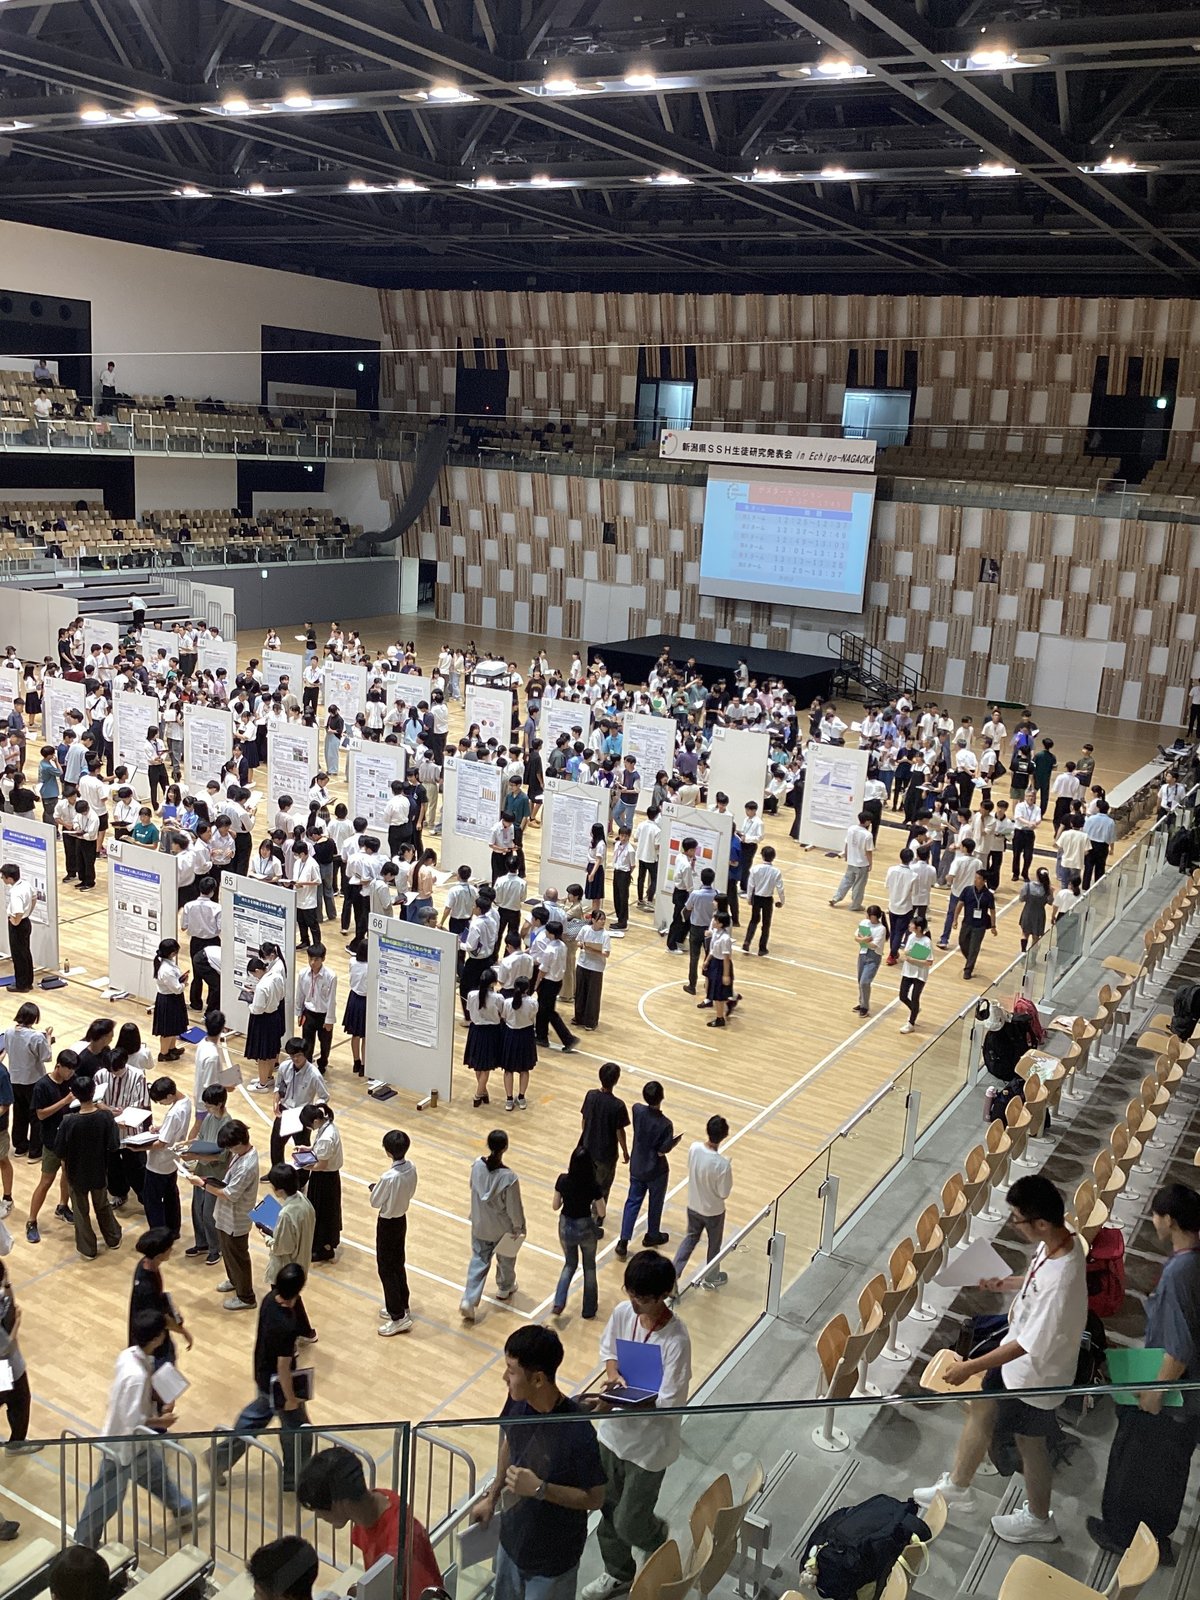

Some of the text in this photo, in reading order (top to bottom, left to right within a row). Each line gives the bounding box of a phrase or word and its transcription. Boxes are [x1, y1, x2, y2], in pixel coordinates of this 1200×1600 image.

[682, 442, 874, 465] 新潟県SSH生徒研究発表会 in Echigo-NAGAOKA
[351, 740, 359, 748] 41
[811, 744, 819, 752] 22
[446, 759, 454, 767] 42
[547, 780, 556, 788] 43
[666, 806, 675, 814] 44
[109, 843, 118, 853] 64
[224, 875, 234, 886] 65
[372, 918, 383, 929] 66
